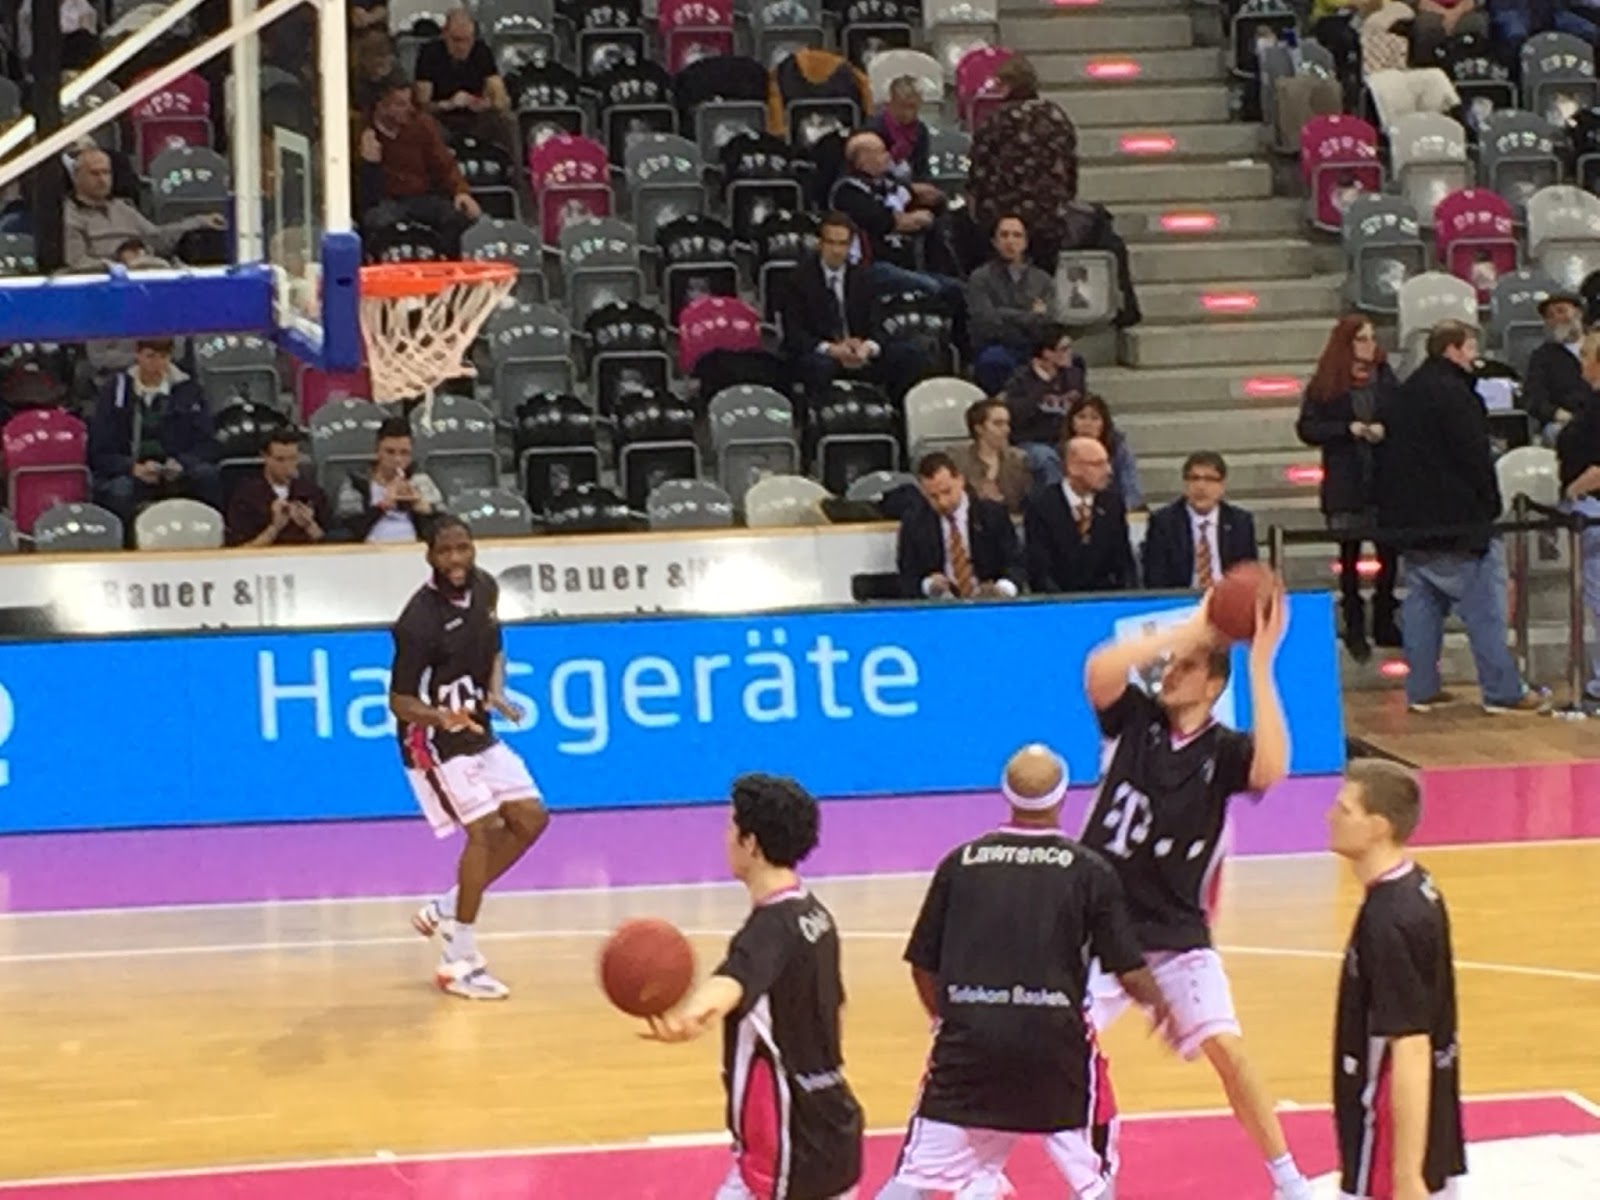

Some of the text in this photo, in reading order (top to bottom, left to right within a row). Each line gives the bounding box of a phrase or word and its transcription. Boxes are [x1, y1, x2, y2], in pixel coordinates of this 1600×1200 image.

[233, 578, 253, 605] &
[531, 561, 687, 593] Bauer &
[258, 627, 919, 755] Hasgeräte
[961, 844, 1074, 868] Lawrence
